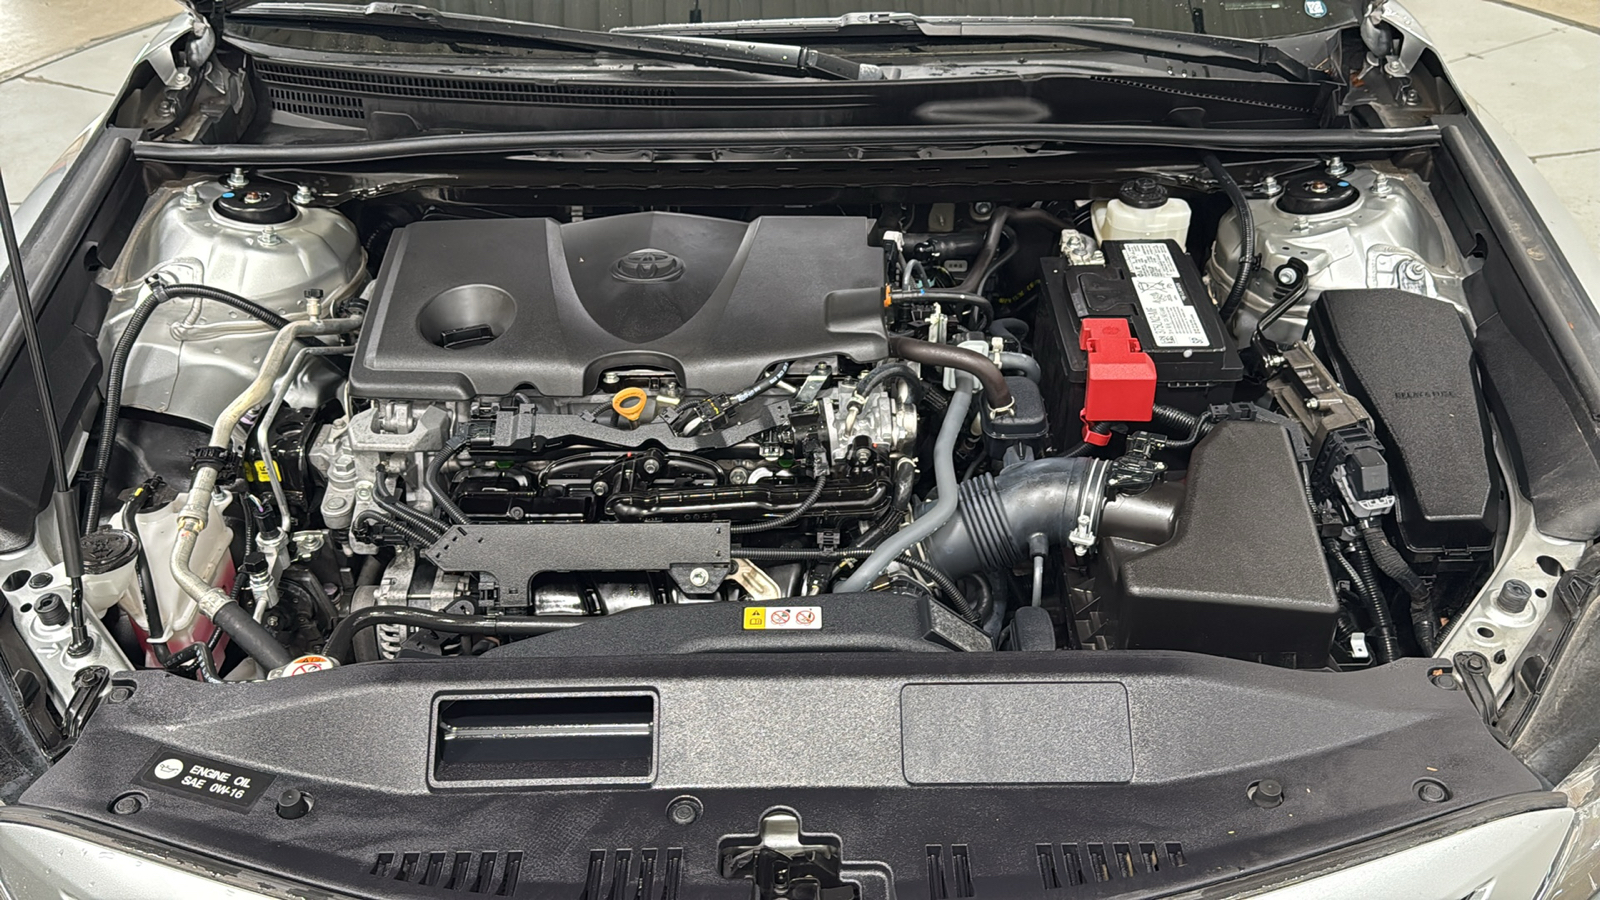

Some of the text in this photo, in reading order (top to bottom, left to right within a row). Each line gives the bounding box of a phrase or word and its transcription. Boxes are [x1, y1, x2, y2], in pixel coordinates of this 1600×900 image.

[181, 775, 245, 799] SAE 0W-16
[189, 764, 252, 789] ENGINE OIL
